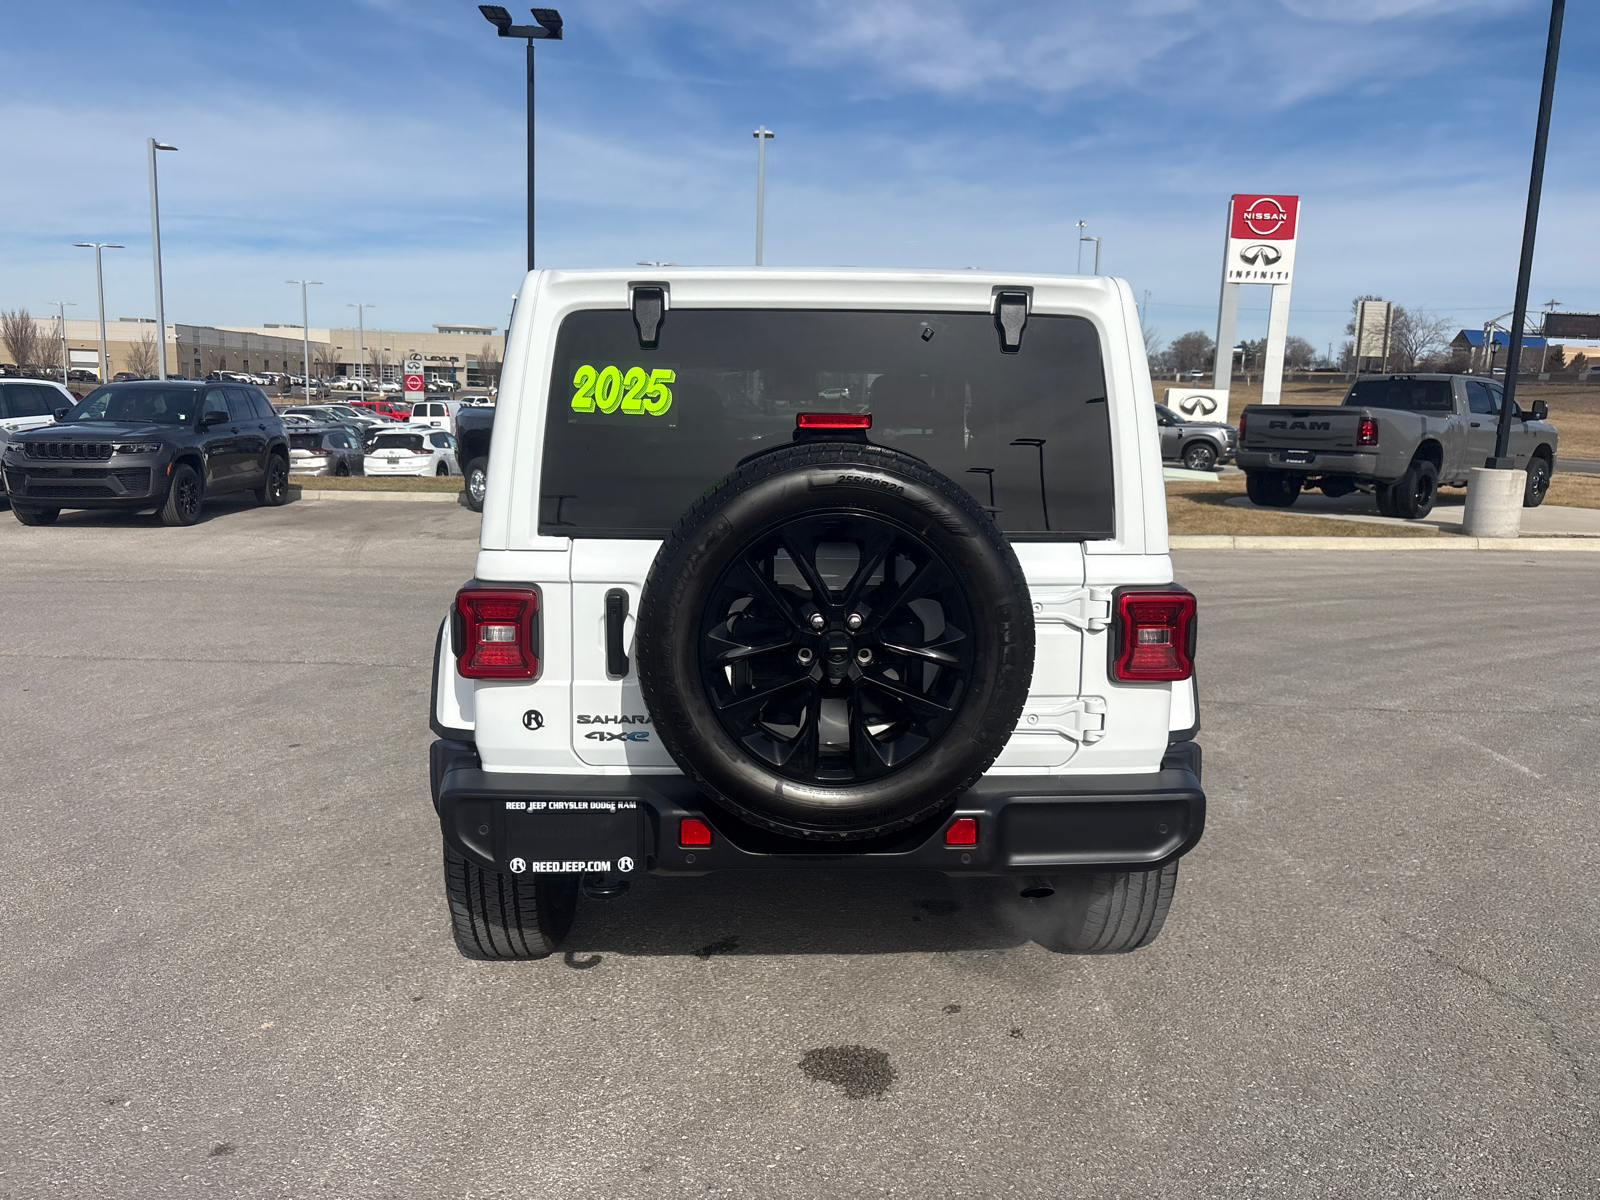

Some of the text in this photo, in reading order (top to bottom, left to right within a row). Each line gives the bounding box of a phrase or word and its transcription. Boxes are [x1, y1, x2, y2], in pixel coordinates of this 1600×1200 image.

[1243, 212, 1287, 220] NISSAN
[1229, 270, 1289, 280] INFINITI
[571, 364, 676, 416] 2025
[1268, 420, 1331, 431] RAM
[838, 474, 905, 496] 255/60R20
[505, 801, 637, 810] REED JEEP CHRYSLER DODGE RAM
[532, 861, 611, 873] REEDJEEP.COM
